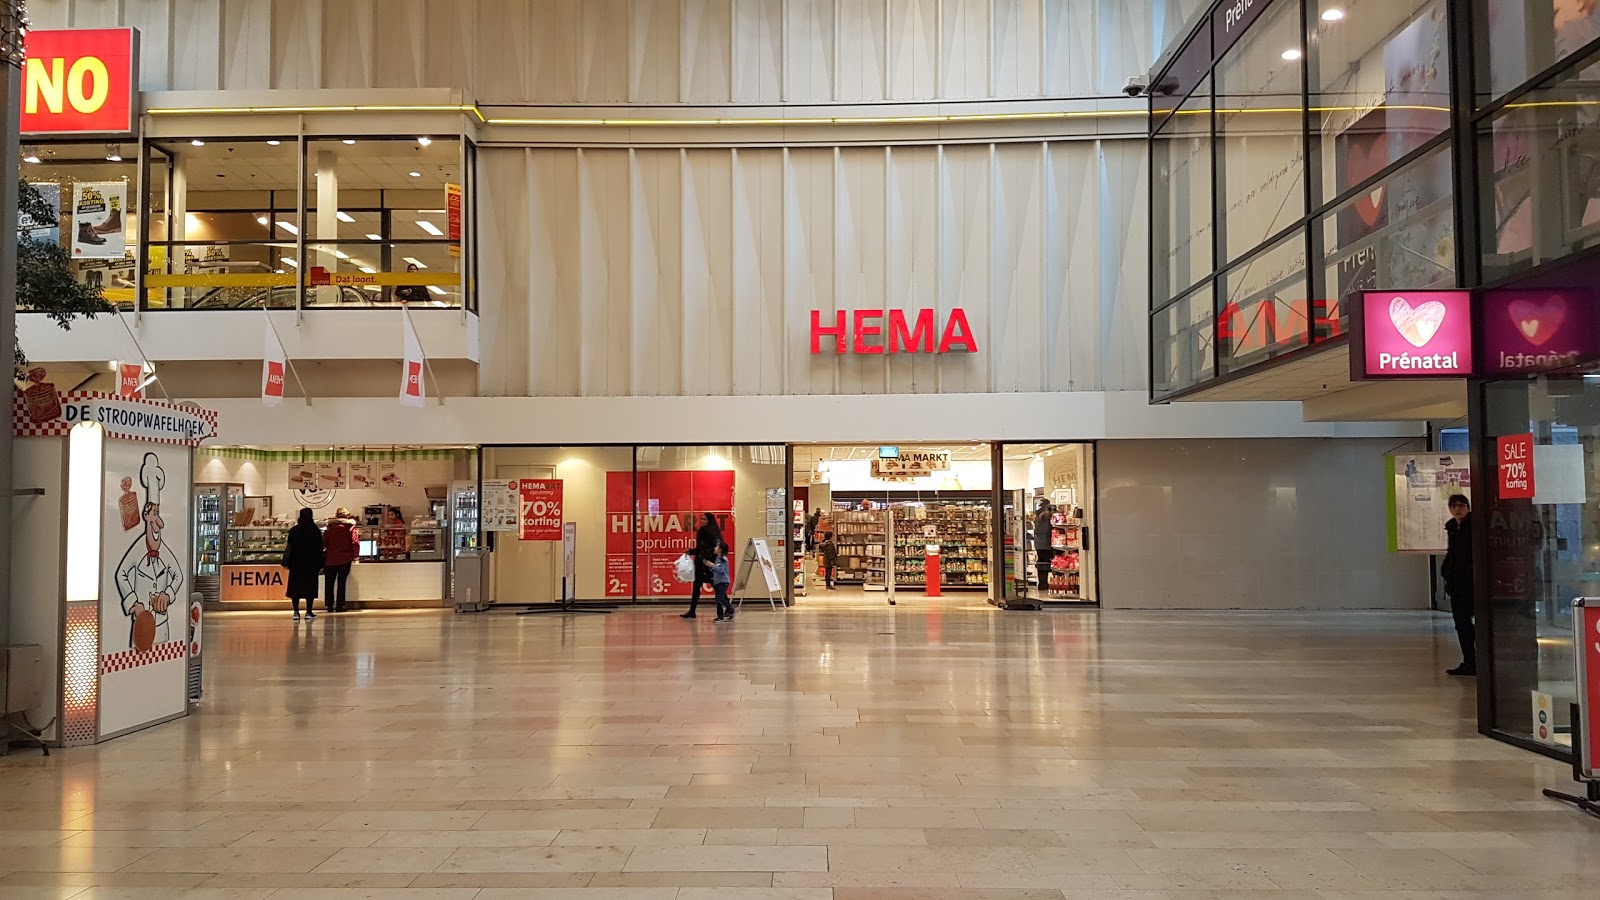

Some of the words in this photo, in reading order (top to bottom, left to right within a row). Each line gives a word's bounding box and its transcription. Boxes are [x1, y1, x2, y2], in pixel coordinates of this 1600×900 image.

[25, 56, 109, 114] NO
[336, 275, 350, 283] Dat
[352, 275, 377, 283] loont.
[810, 308, 978, 354] HEMA
[1379, 351, 1458, 369] Prénatal
[65, 405, 91, 421] DE
[97, 406, 205, 435] STROOPWAFELHOEK
[913, 453, 948, 462] MARKT
[1504, 442, 1526, 460] SALE
[1053, 472, 1077, 484] HEM
[1505, 462, 1527, 479] 70%
[1506, 479, 1528, 491] korting
[522, 501, 561, 516] 70%
[636, 536, 697, 552] opruimin
[230, 571, 284, 586] HEMA
